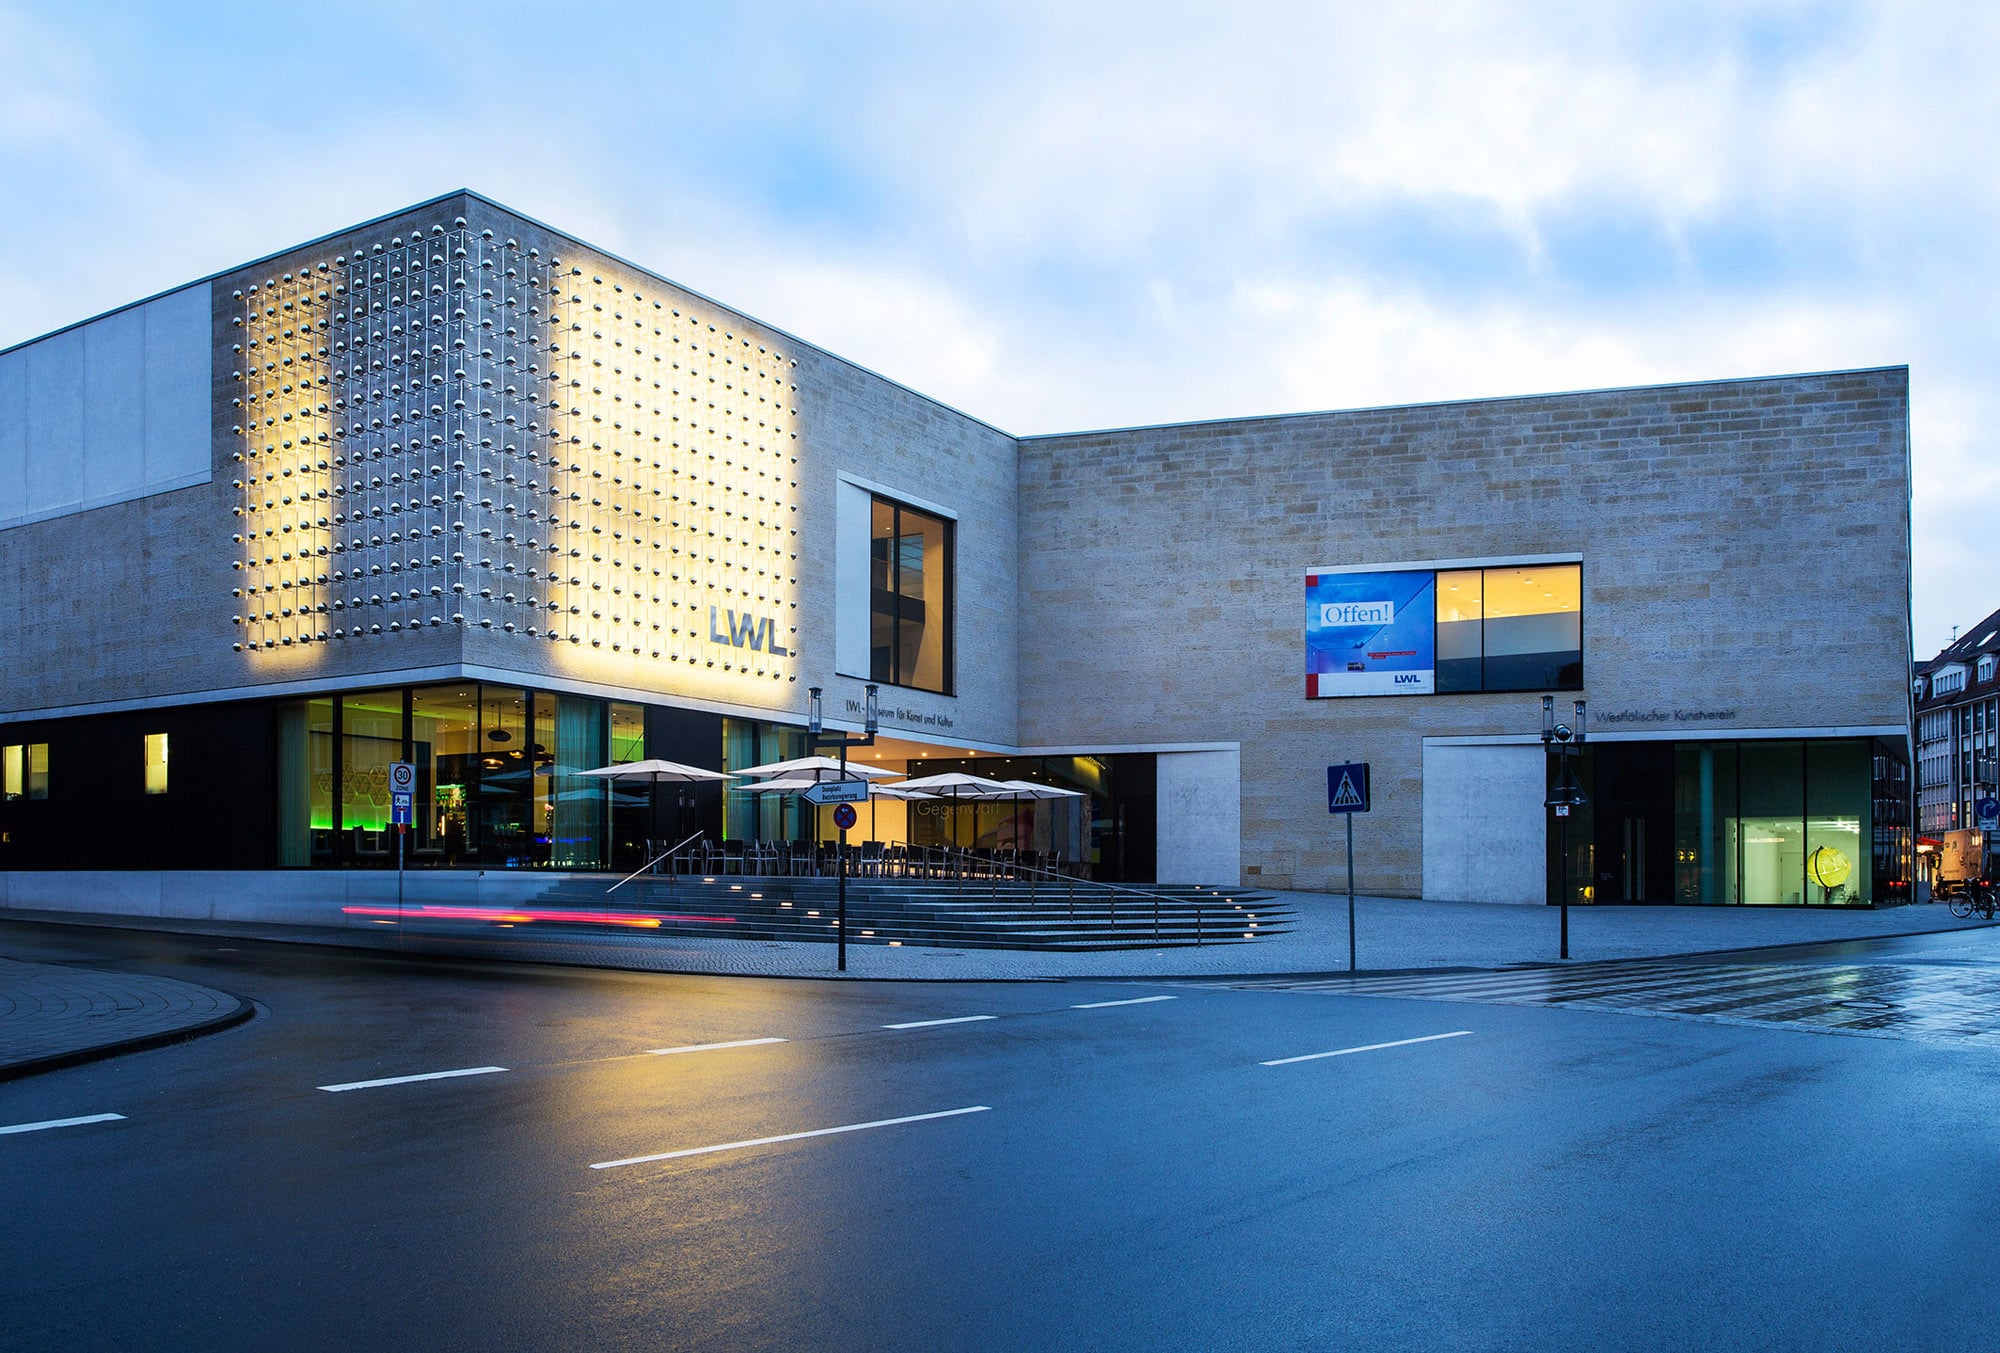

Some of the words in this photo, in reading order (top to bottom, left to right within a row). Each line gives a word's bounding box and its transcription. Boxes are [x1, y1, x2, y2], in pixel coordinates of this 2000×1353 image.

[1325, 604, 1389, 624] Offen!
[710, 605, 788, 657] LWL
[1394, 674, 1421, 684] LWL
[896, 707, 905, 720] für
[906, 710, 923, 722] Kunst
[924, 713, 936, 725] und
[937, 714, 953, 728] Kultur
[1674, 709, 1736, 721] Kunstverein
[397, 770, 408, 780] 30
